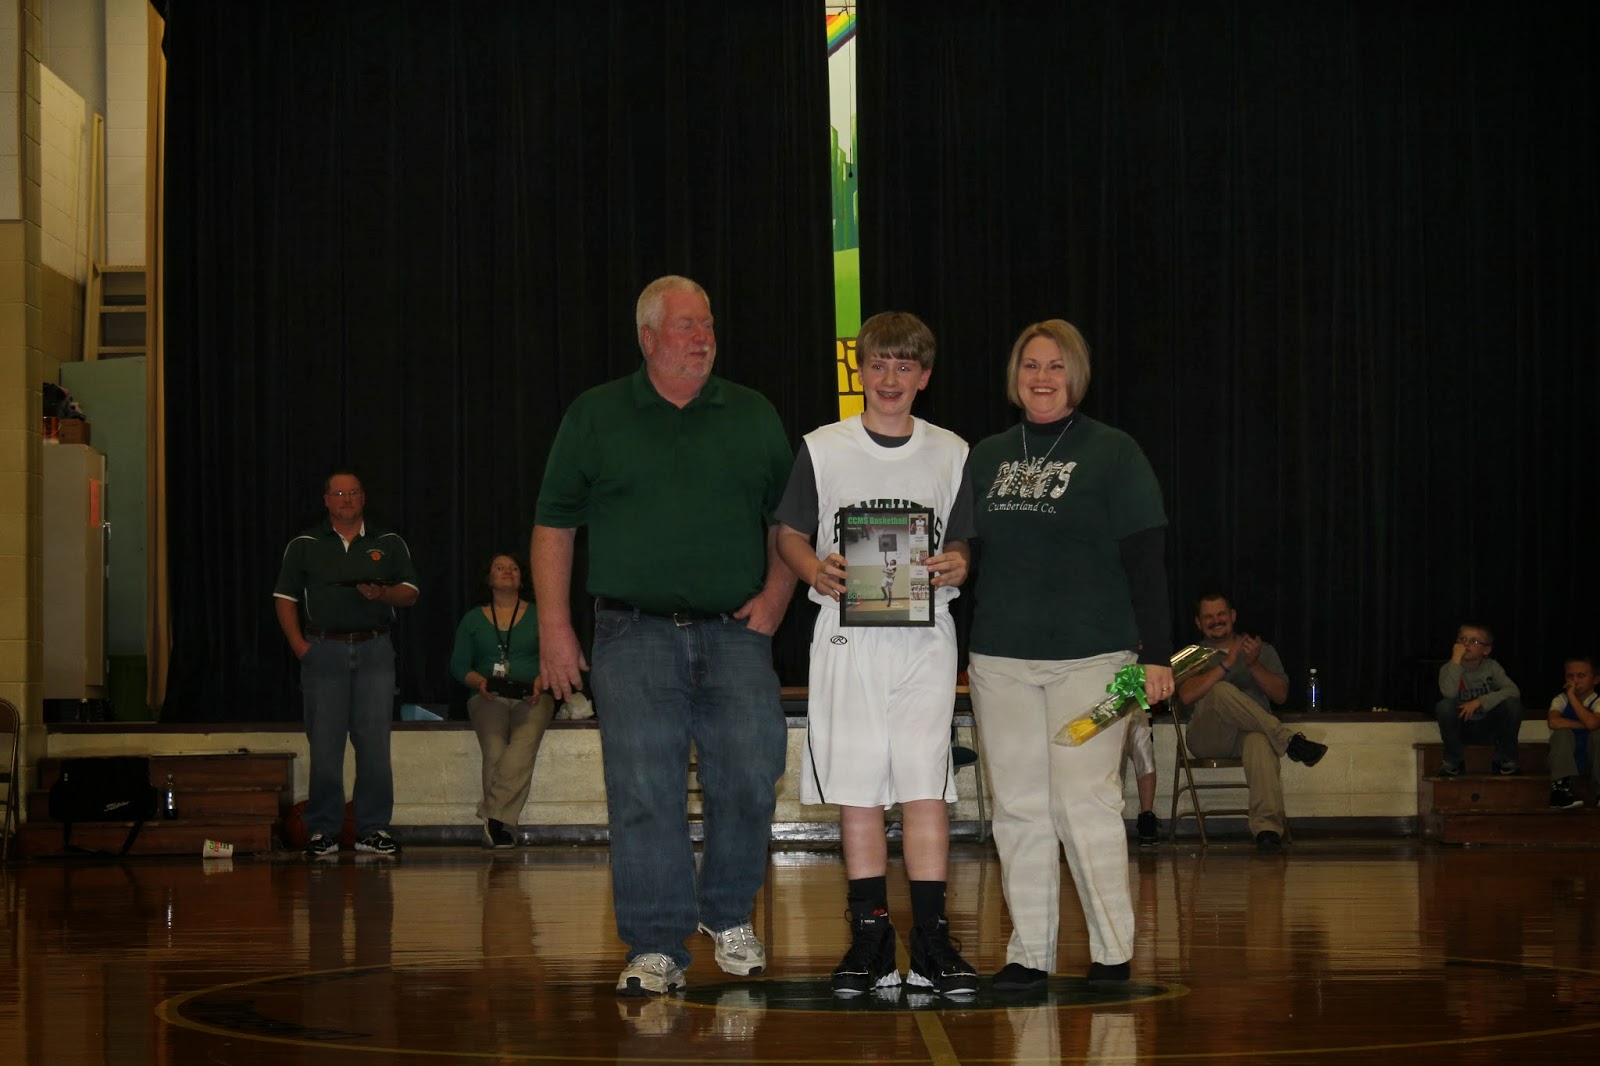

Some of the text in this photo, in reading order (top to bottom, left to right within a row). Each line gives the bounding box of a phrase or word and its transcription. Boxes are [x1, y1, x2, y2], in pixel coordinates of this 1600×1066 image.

[988, 500, 1057, 514] Cumberland Co.
[847, 516, 908, 525] CCMS Basketball
